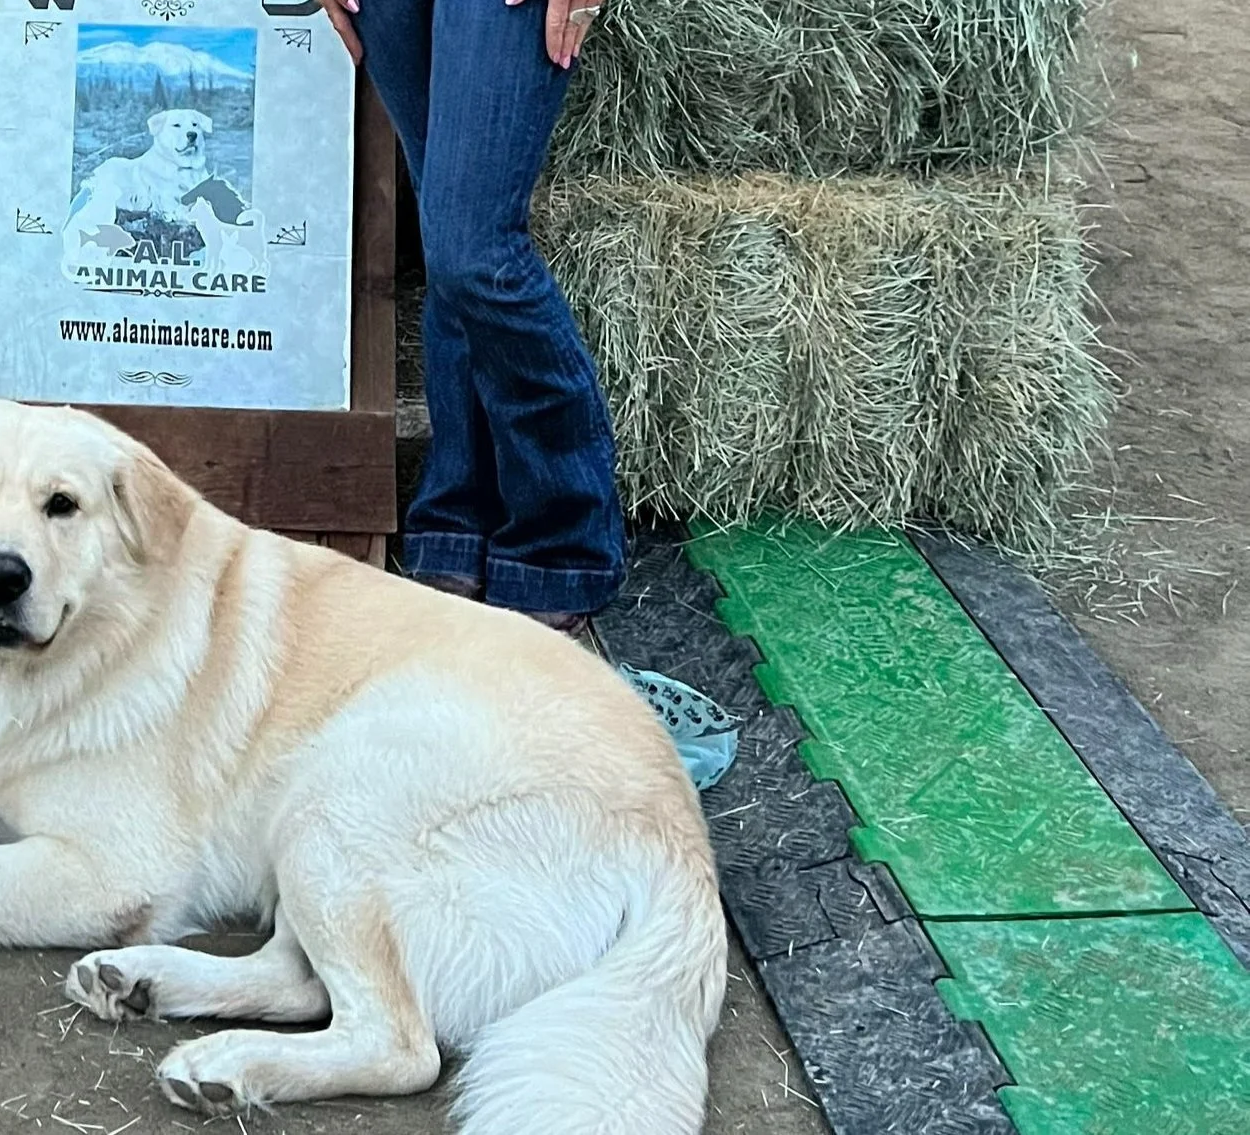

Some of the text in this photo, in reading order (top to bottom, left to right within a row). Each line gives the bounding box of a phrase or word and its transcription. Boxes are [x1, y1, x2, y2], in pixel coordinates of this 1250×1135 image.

[133, 239, 200, 266] A.L.
[192, 272, 267, 293] CARE
[59, 317, 273, 351] www.alanimalcare.com
